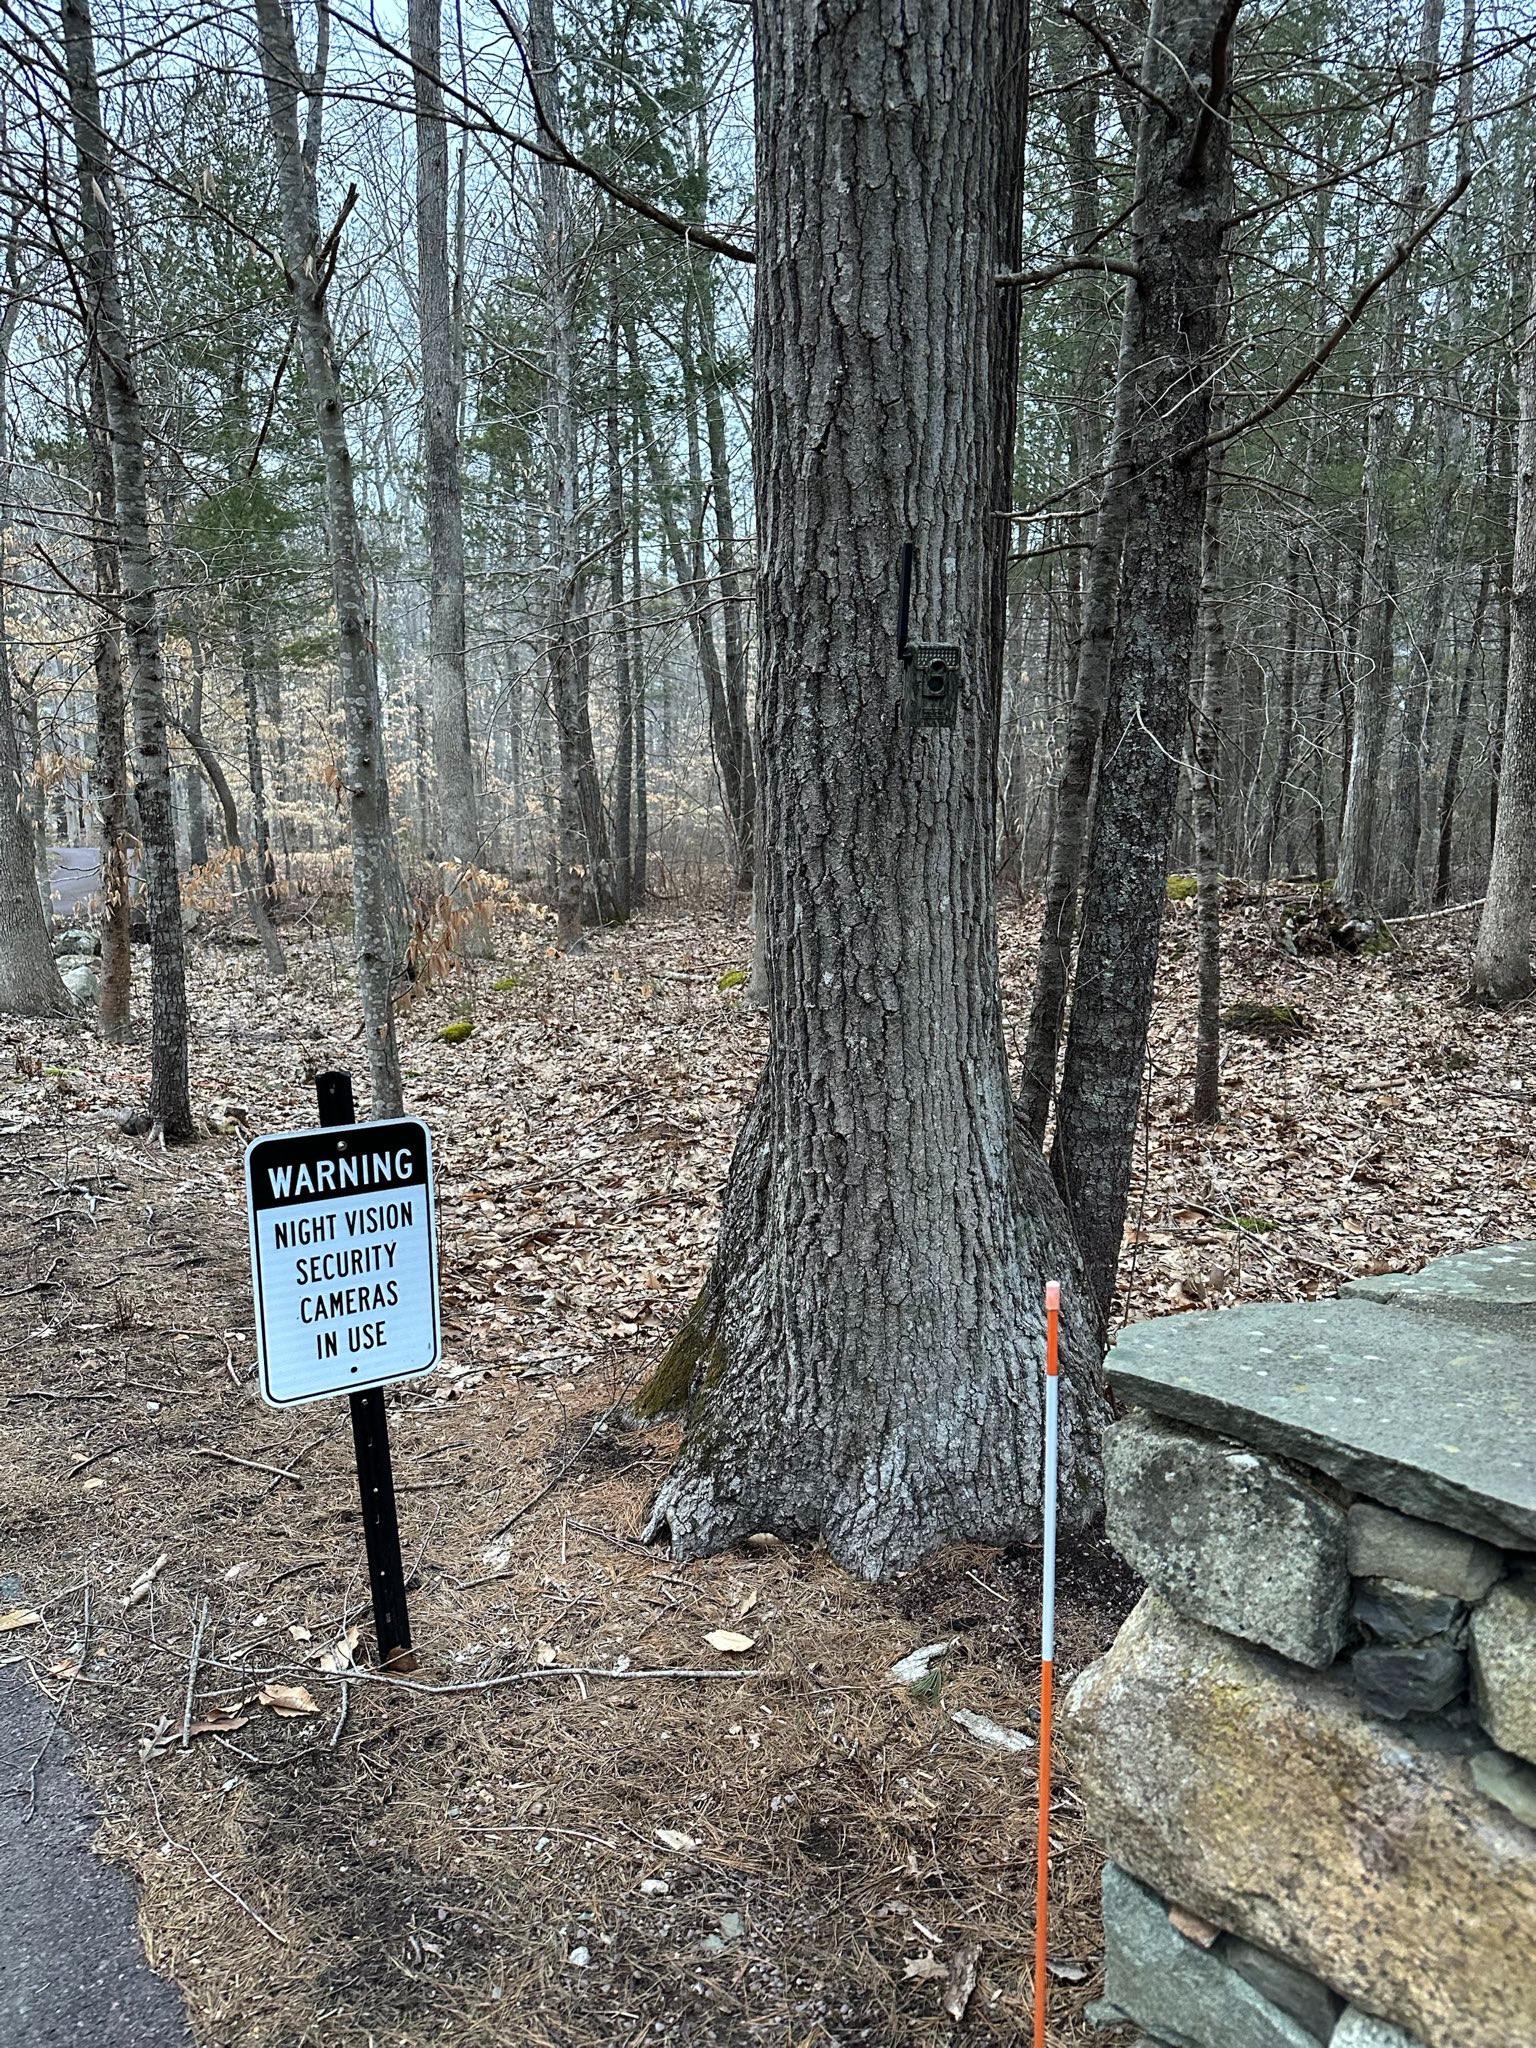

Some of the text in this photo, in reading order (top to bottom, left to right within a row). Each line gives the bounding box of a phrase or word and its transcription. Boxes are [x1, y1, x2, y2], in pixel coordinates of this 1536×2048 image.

[268, 1148, 413, 1199] WARNING
[274, 1201, 413, 1249] NIGHT VISION
[296, 1242, 397, 1285] SECURITY
[301, 1280, 398, 1324] CAMERAS
[316, 1321, 387, 1360] IN USE
